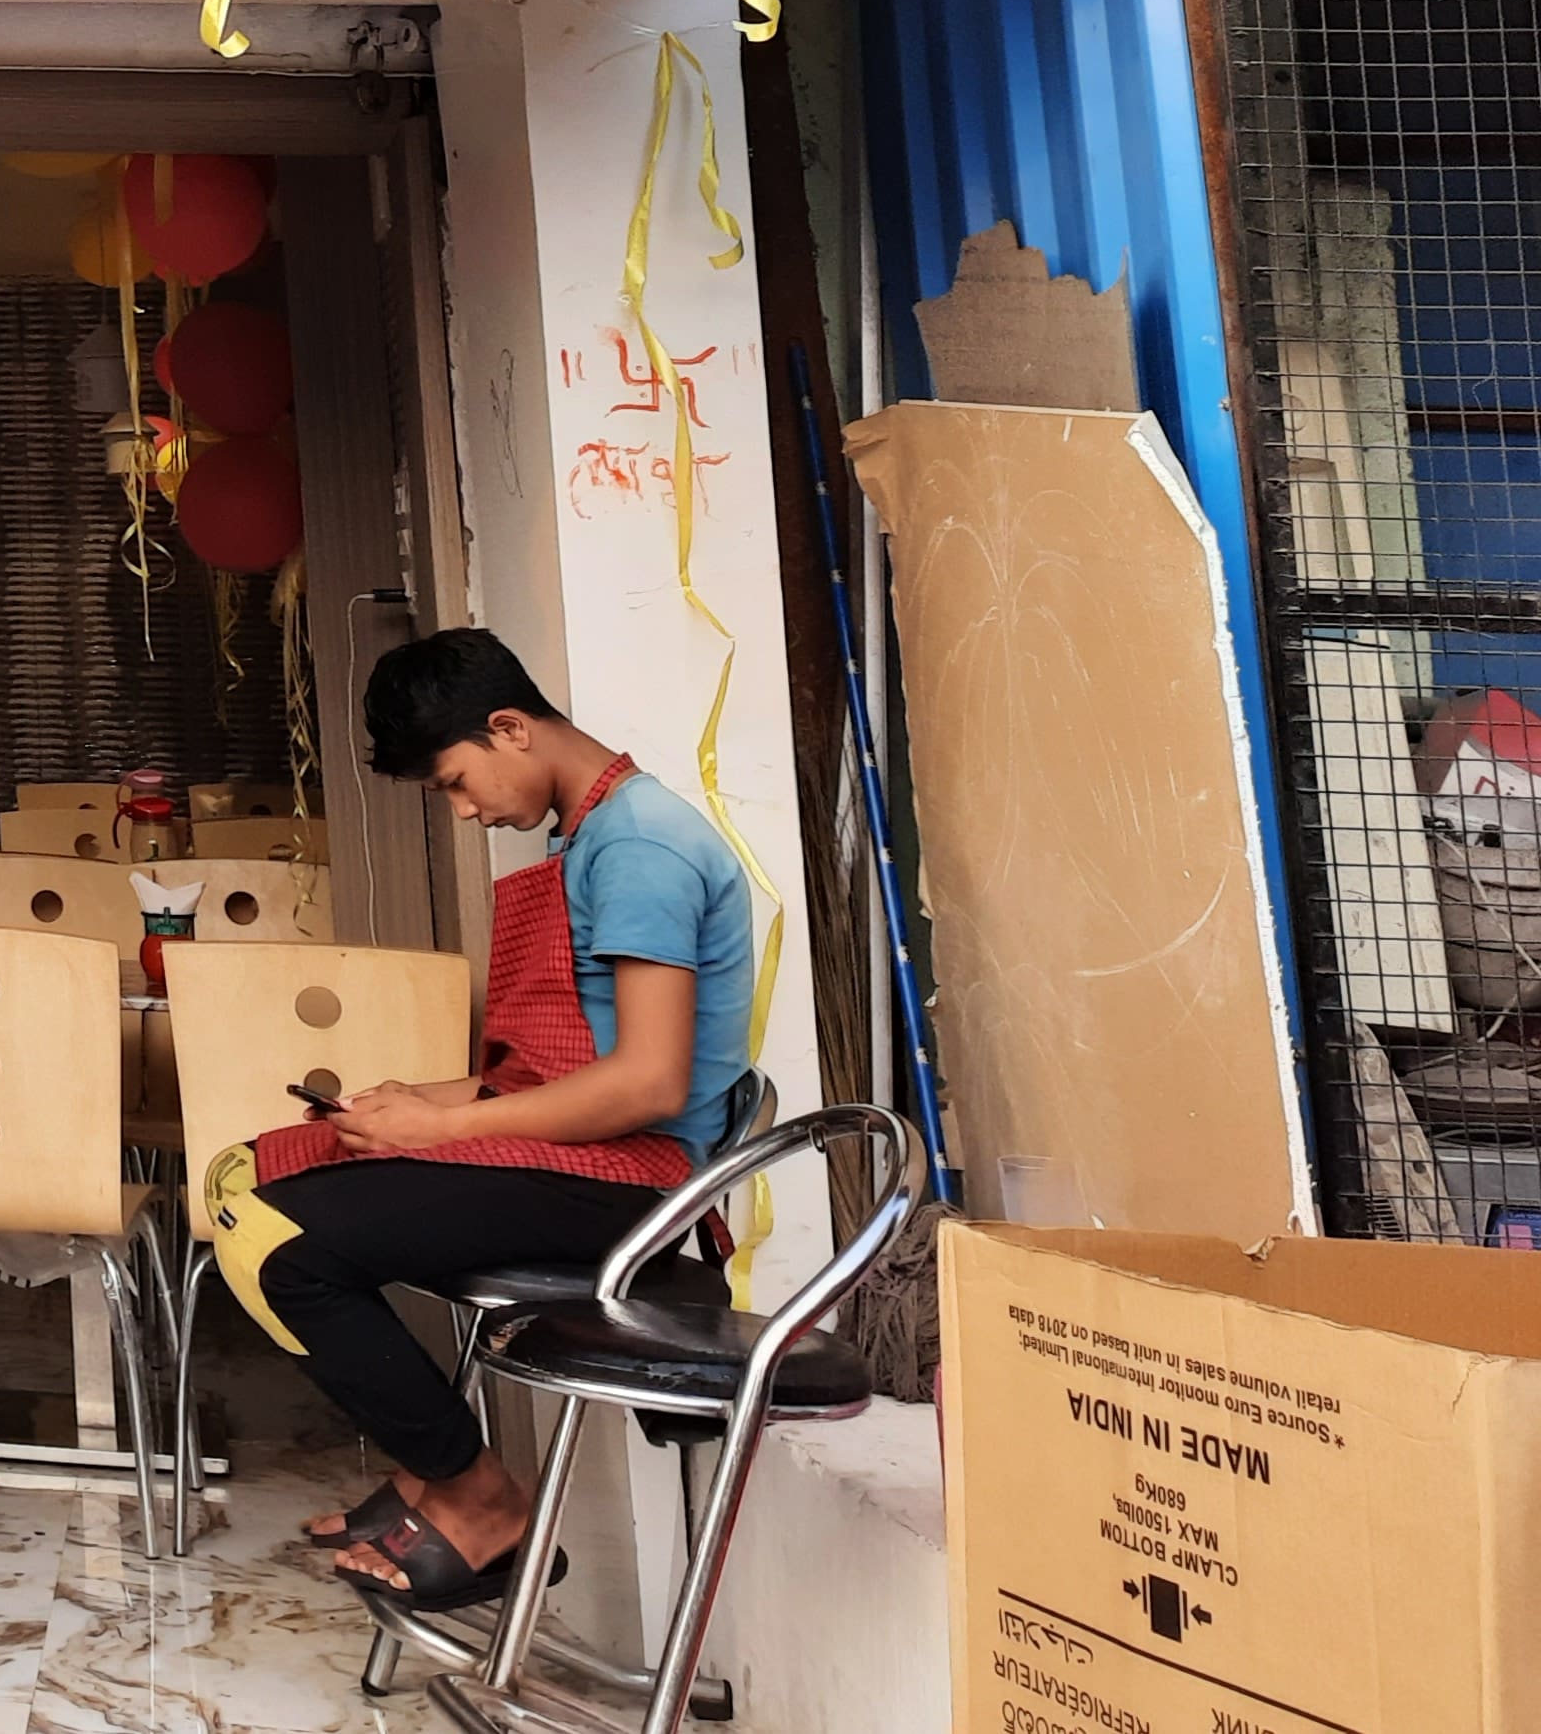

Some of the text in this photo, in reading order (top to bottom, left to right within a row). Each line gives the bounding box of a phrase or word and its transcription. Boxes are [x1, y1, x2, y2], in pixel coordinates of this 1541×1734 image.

[1009, 1304, 1341, 1414] retail volume sales in unit based on 2018 data
[1072, 1350, 1154, 1392] international
[1159, 1377, 1219, 1408] monitor
[1225, 1396, 1262, 1424] Euro
[1067, 1388, 1270, 1485] MADE IN INDIA
[1268, 1409, 1330, 1443] Source
[1135, 1474, 1185, 1512] 680Kg
[1100, 1519, 1238, 1586] CLAMP BOTTOM
[1177, 1520, 1218, 1552] MAX
